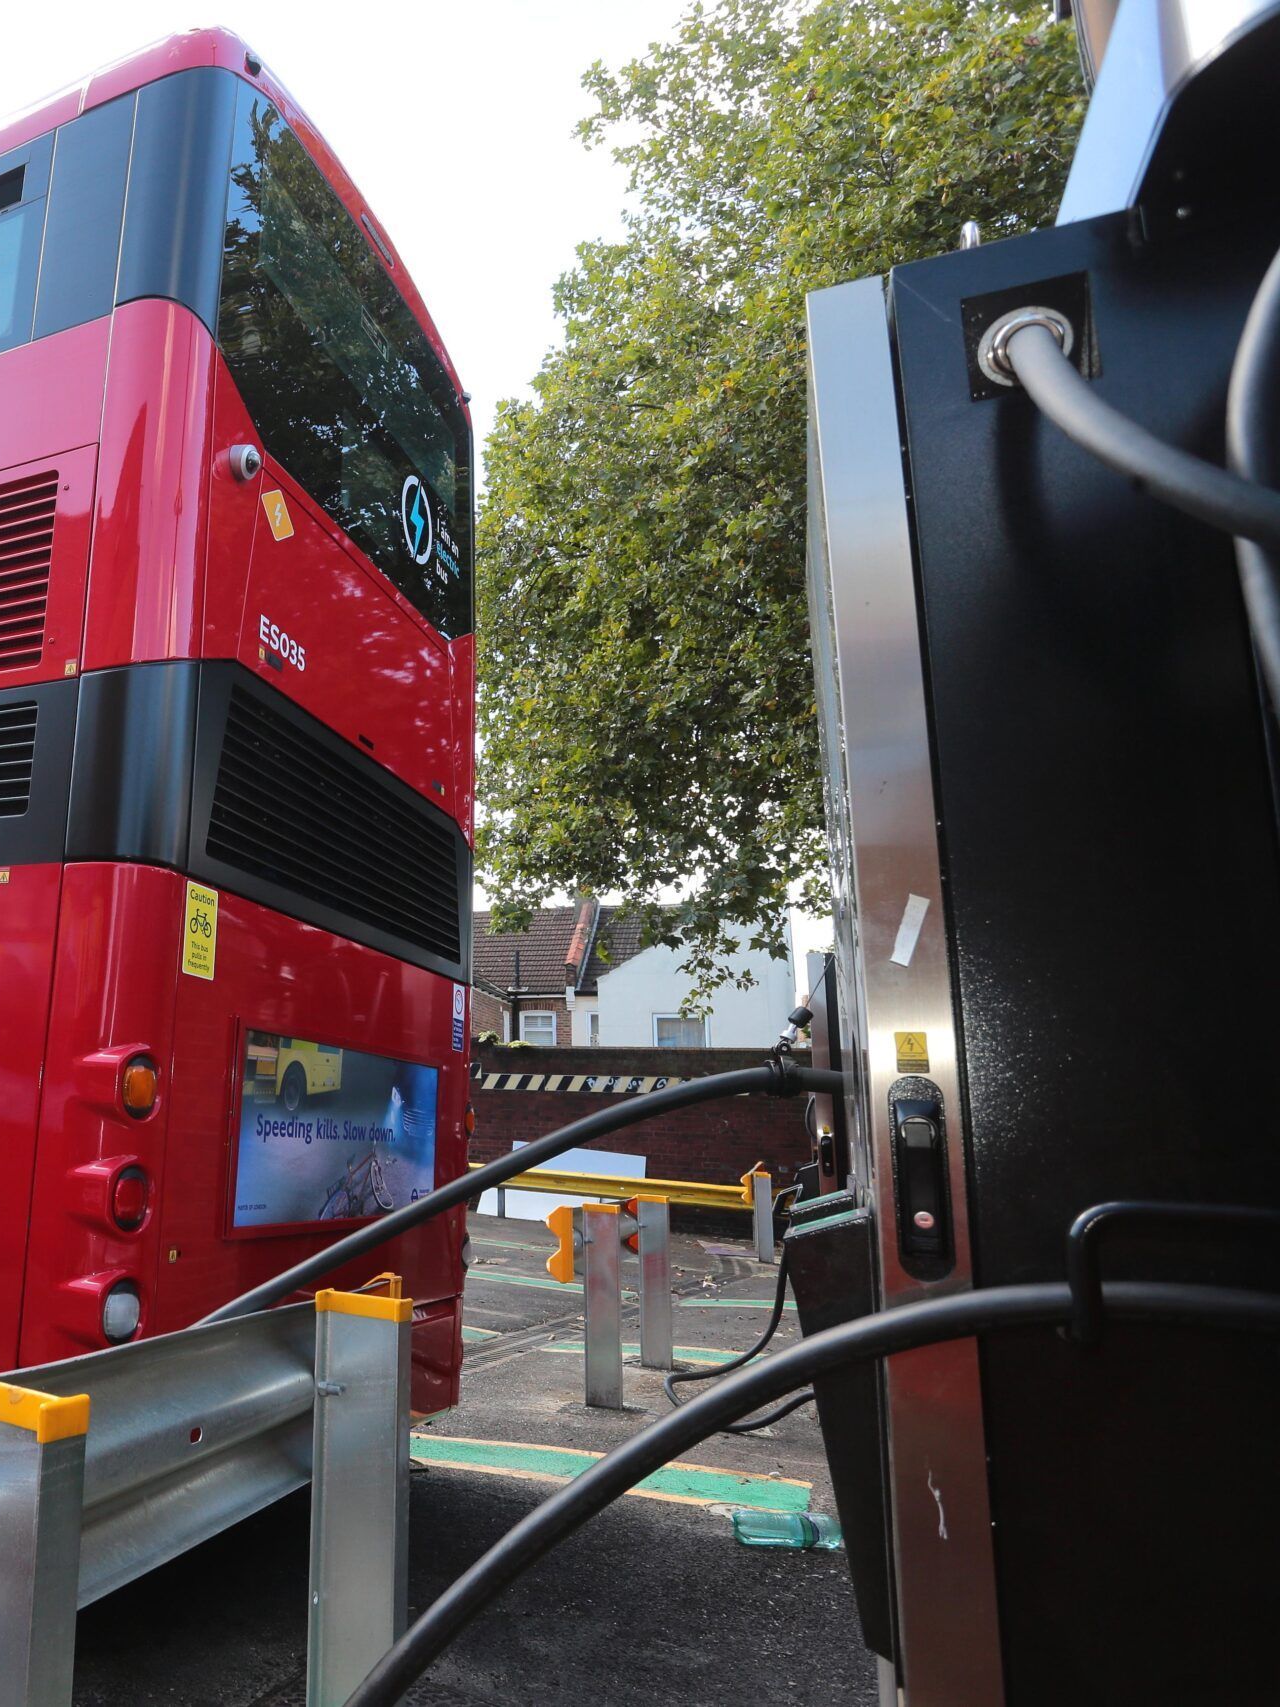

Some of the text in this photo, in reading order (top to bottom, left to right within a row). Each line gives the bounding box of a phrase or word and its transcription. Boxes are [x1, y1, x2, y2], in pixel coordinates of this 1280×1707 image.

[441, 527, 451, 547] am
[451, 541, 459, 558] an
[436, 542, 460, 579] electric
[436, 559, 448, 585] bus
[260, 614, 306, 672] ES035
[190, 889, 215, 906] Caution
[191, 941, 200, 950] This
[191, 952, 202, 960] pulls
[187, 959, 210, 973] frequently
[256, 1113, 396, 1145] Speeding kills. Slow down.
